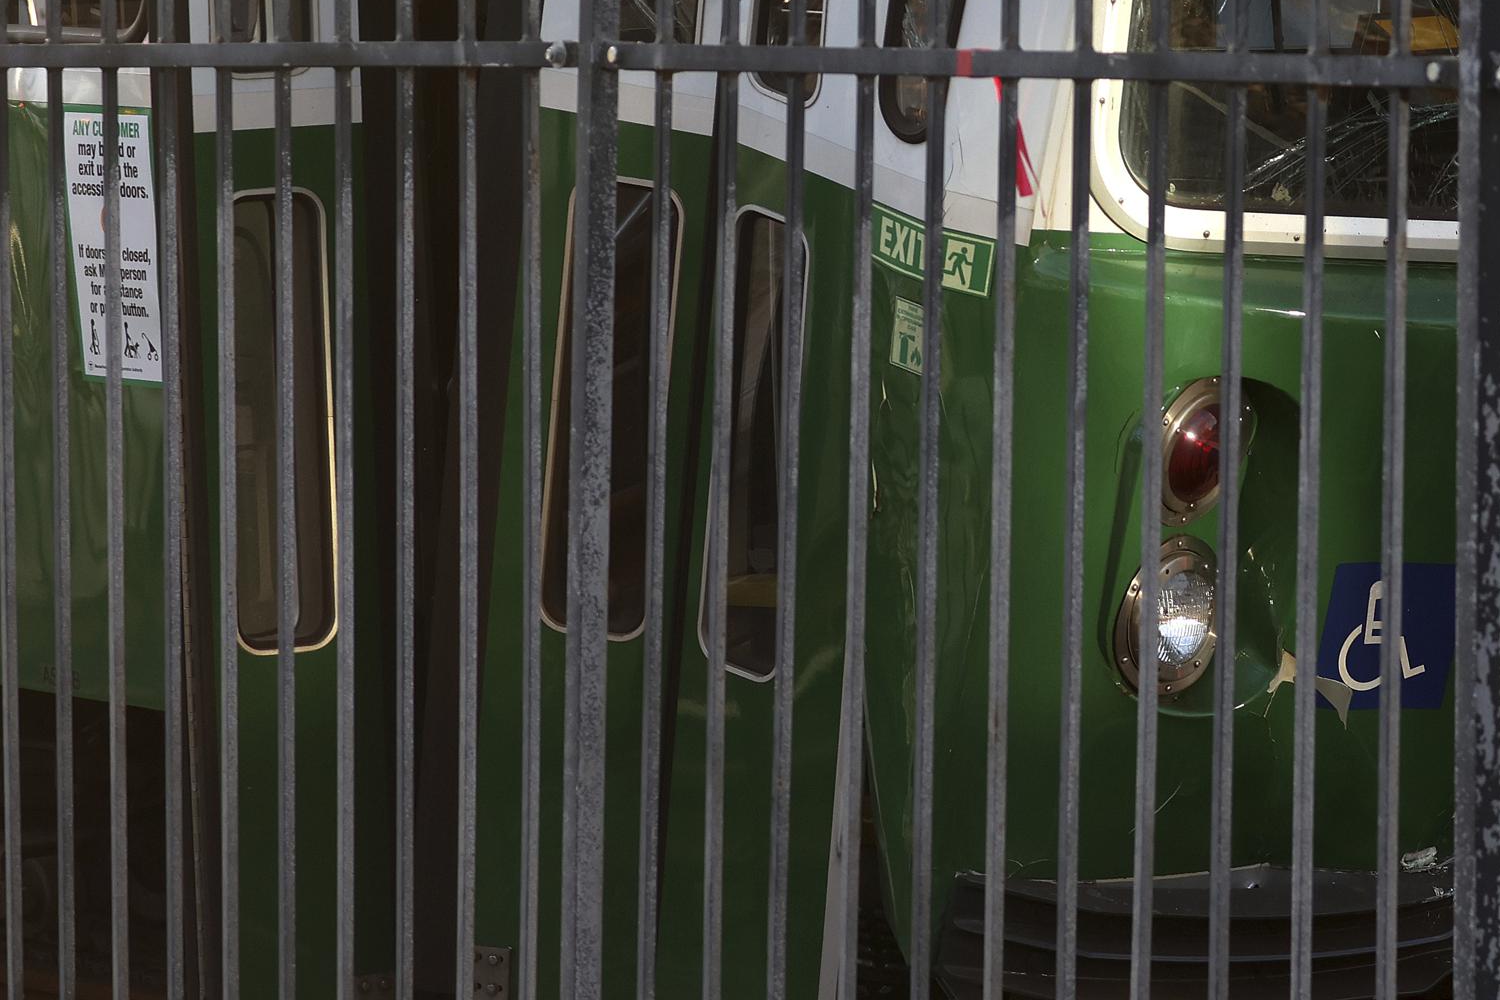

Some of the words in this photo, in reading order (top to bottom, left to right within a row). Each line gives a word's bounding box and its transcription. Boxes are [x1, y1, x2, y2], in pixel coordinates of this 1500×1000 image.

[72, 119, 91, 136] ANY
[92, 120, 140, 139] CUMER
[78, 142, 97, 159] may
[126, 146, 136, 158] or
[78, 160, 95, 177] exit
[123, 161, 138, 179] the
[72, 181, 104, 197] accessi
[120, 182, 149, 199] doors.
[879, 215, 926, 271] EXIT
[78, 244, 84, 259] If
[122, 248, 151, 265] closed,
[84, 264, 97, 278] ask
[90, 281, 102, 295] for
[90, 302, 98, 314] or
[122, 302, 149, 318] button.
